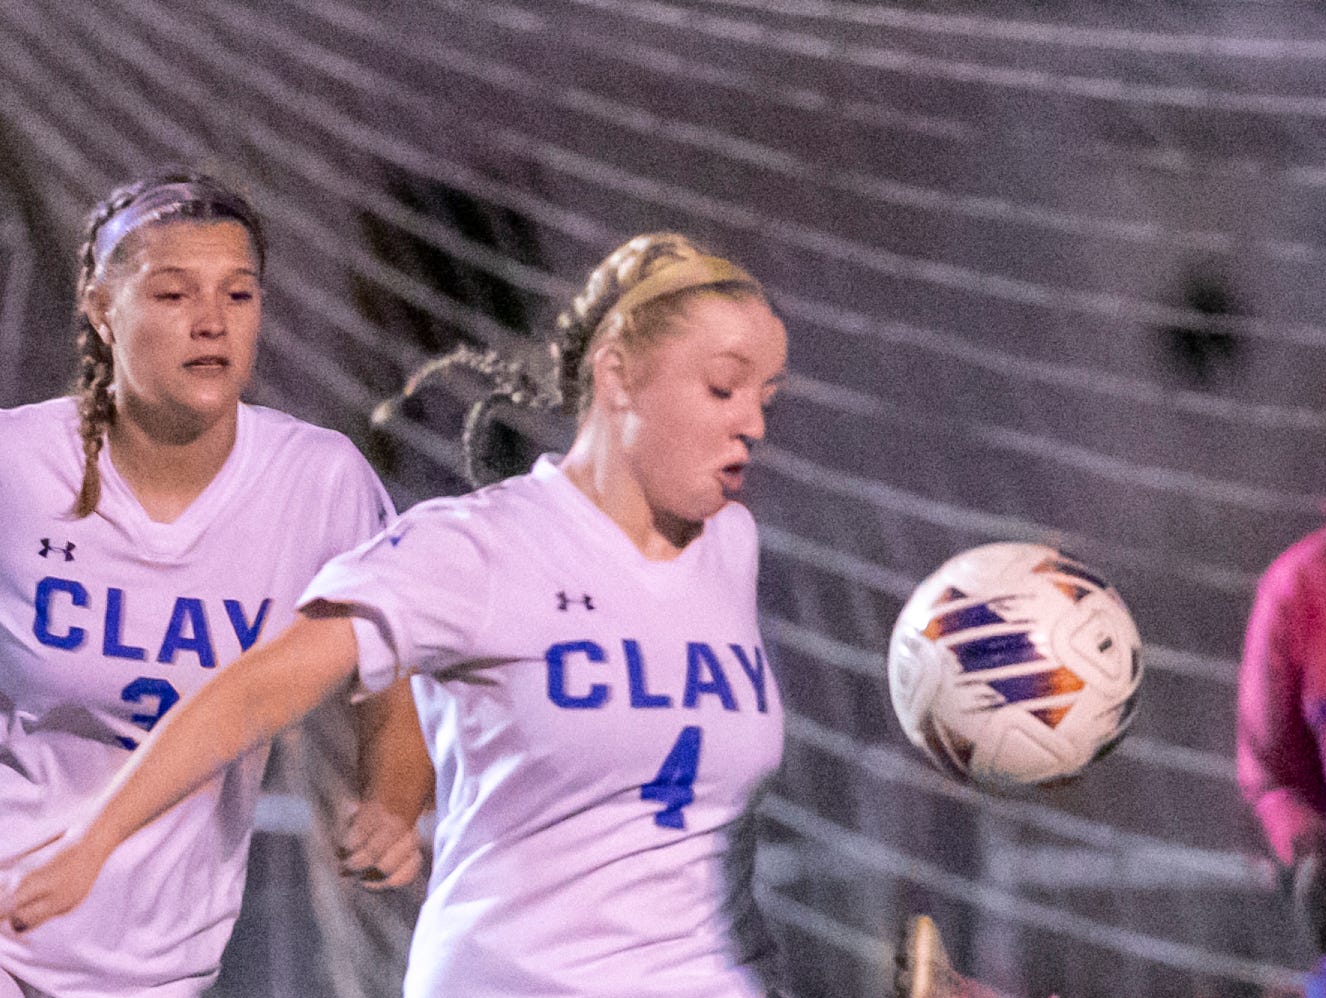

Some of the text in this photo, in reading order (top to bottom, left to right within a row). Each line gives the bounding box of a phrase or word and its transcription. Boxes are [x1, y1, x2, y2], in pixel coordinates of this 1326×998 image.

[33, 576, 273, 669] CLAY
[545, 638, 767, 713] CLAY
[640, 726, 703, 830] 4
